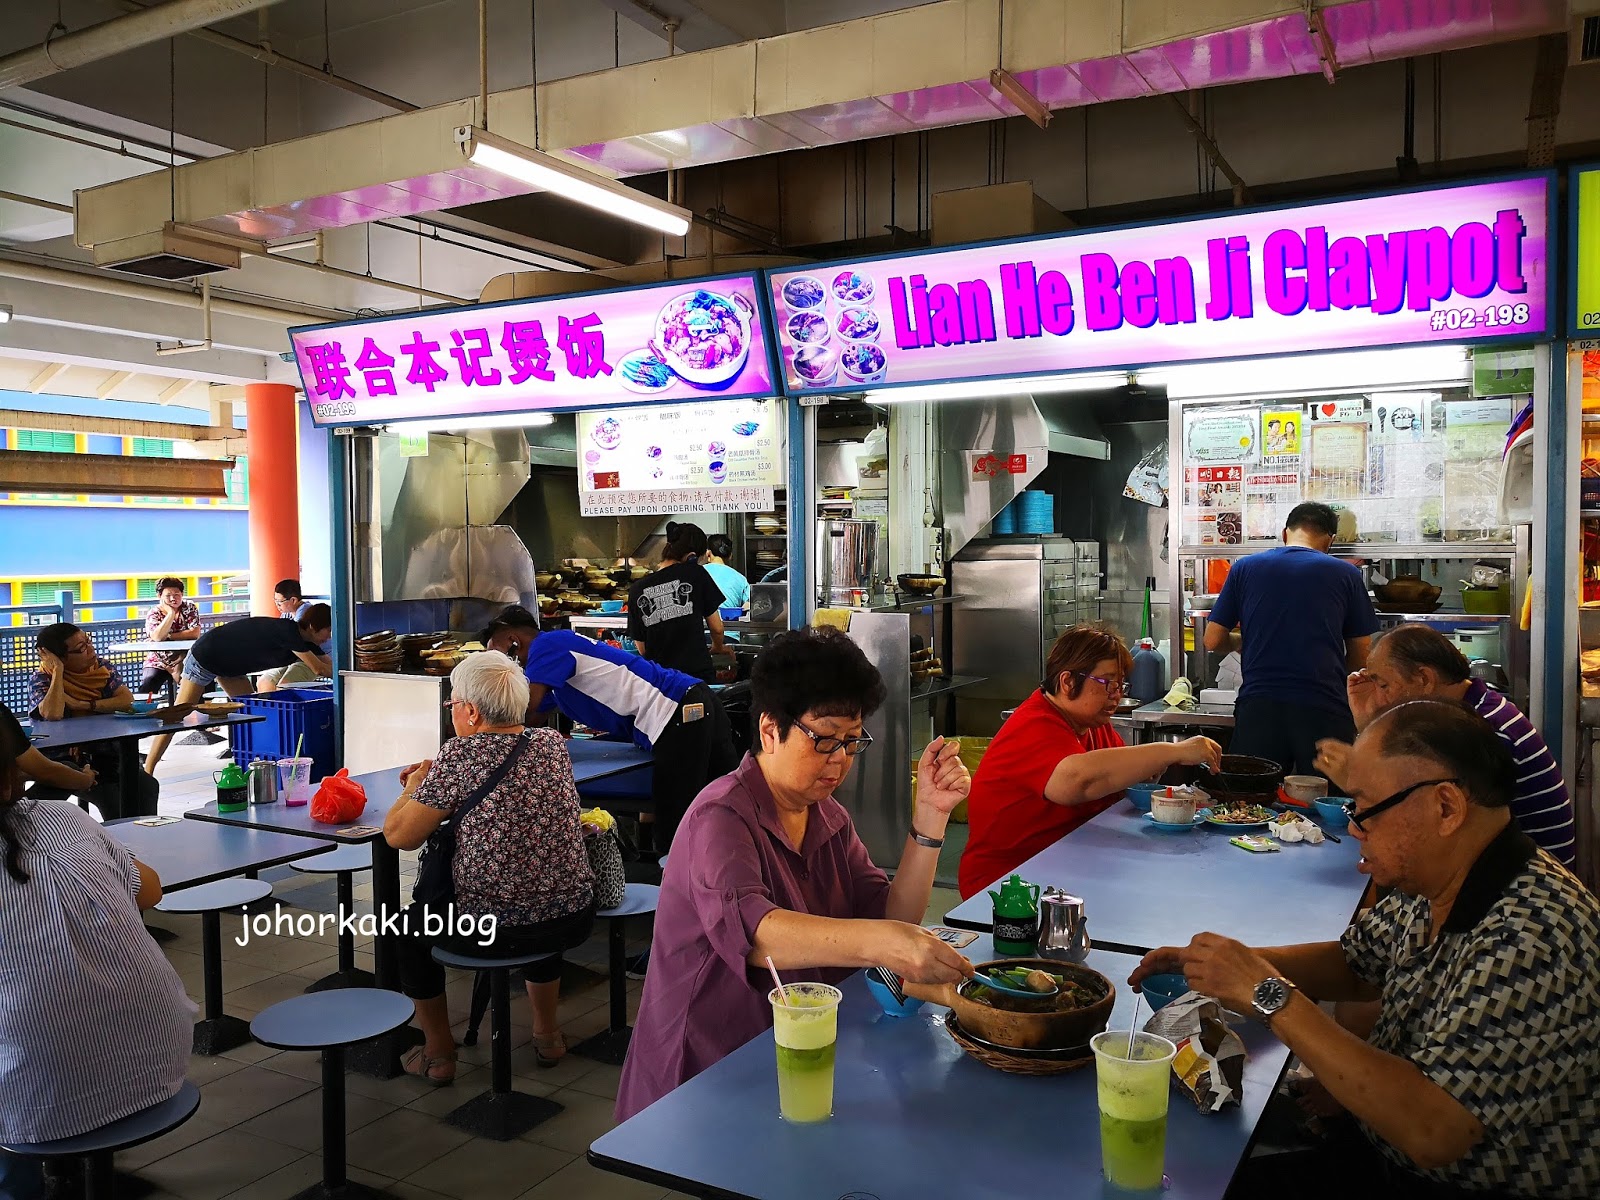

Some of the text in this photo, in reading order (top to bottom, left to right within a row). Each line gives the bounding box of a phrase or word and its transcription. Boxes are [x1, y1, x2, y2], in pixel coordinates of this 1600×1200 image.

[888, 209, 1527, 350] Lian He Ben Ji Claypot
[1430, 302, 1530, 331] #02-198
[304, 312, 614, 400] 联合本记煲饭
[803, 396, 824, 405] 02-198
[316, 401, 356, 418] #02-199
[1310, 404, 1319, 421] I
[757, 462, 772, 470] $3.00
[1263, 456, 1280, 465] NO.1
[690, 466, 704, 474] $2.50
[584, 506, 614, 515] PLEASE
[618, 506, 632, 514] PAY
[636, 505, 658, 513] UPON
[710, 503, 740, 511] THANK
[745, 502, 762, 510] YOU
